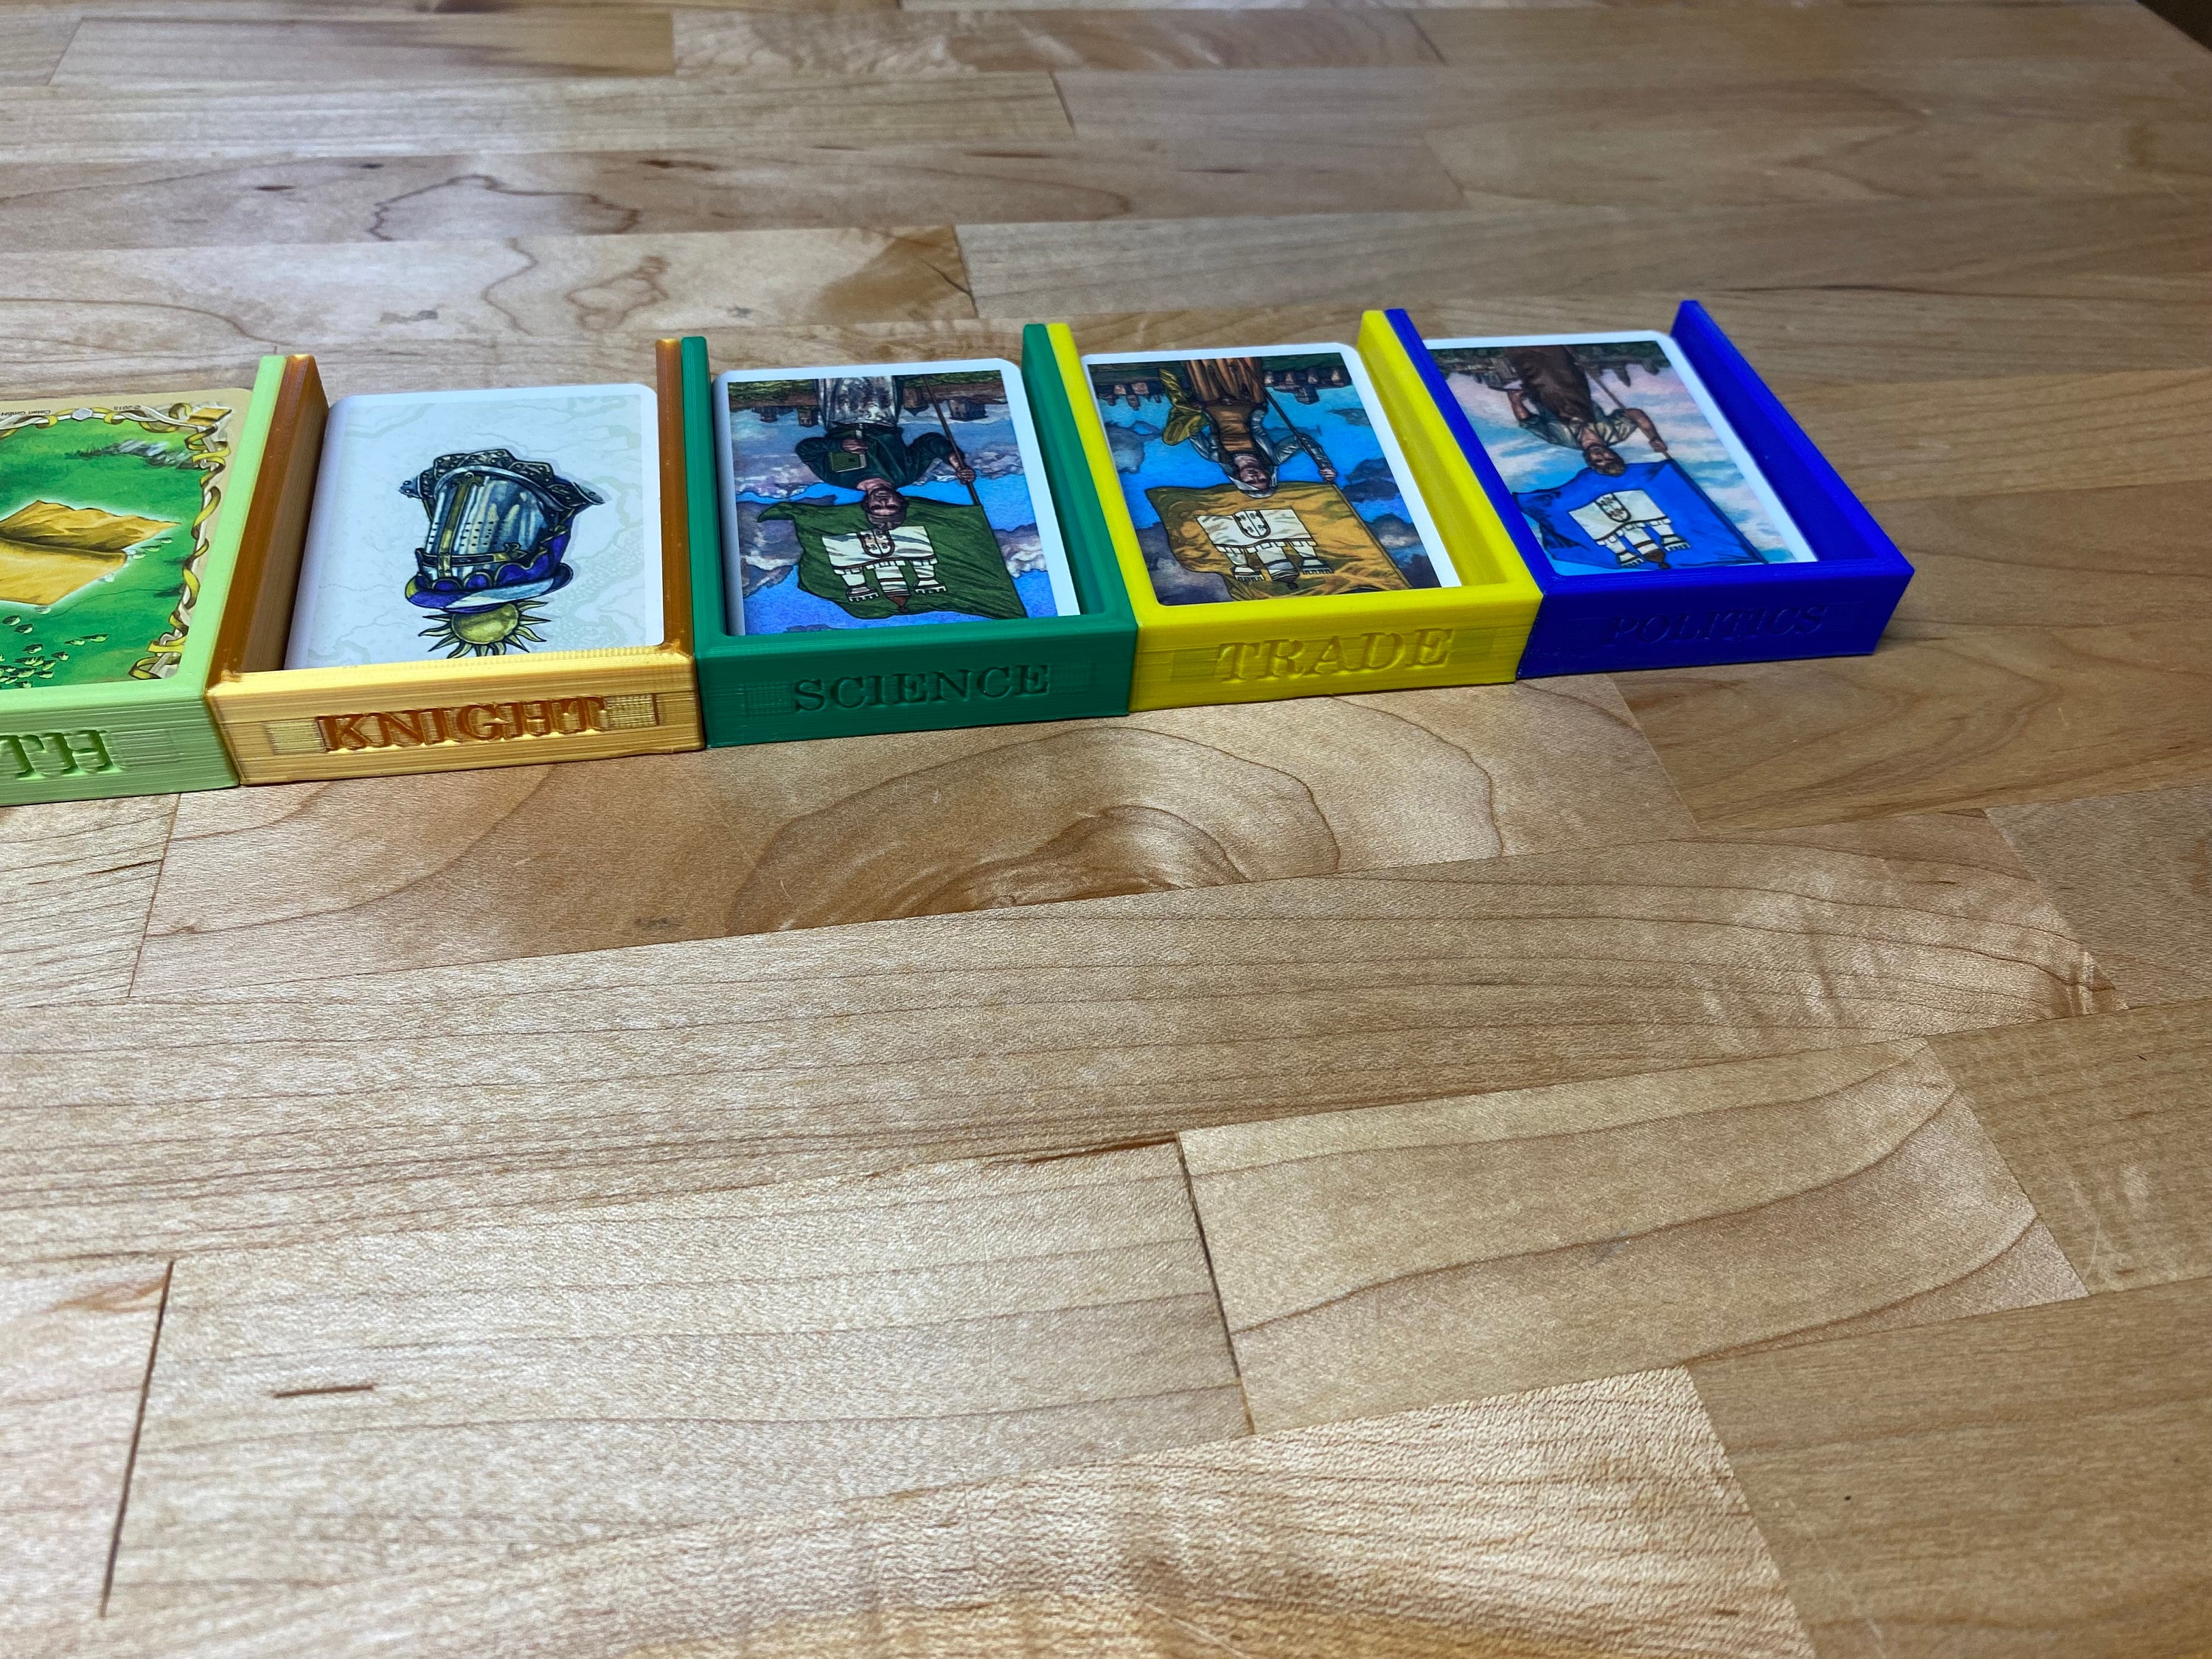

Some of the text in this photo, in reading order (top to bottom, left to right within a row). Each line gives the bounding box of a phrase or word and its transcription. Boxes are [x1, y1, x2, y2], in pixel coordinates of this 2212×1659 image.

[1603, 605, 1829, 647] POLITICS
[1217, 628, 1455, 684] TRADE
[794, 664, 1050, 712] SCIENCE
[317, 695, 606, 751] KNIGHT
